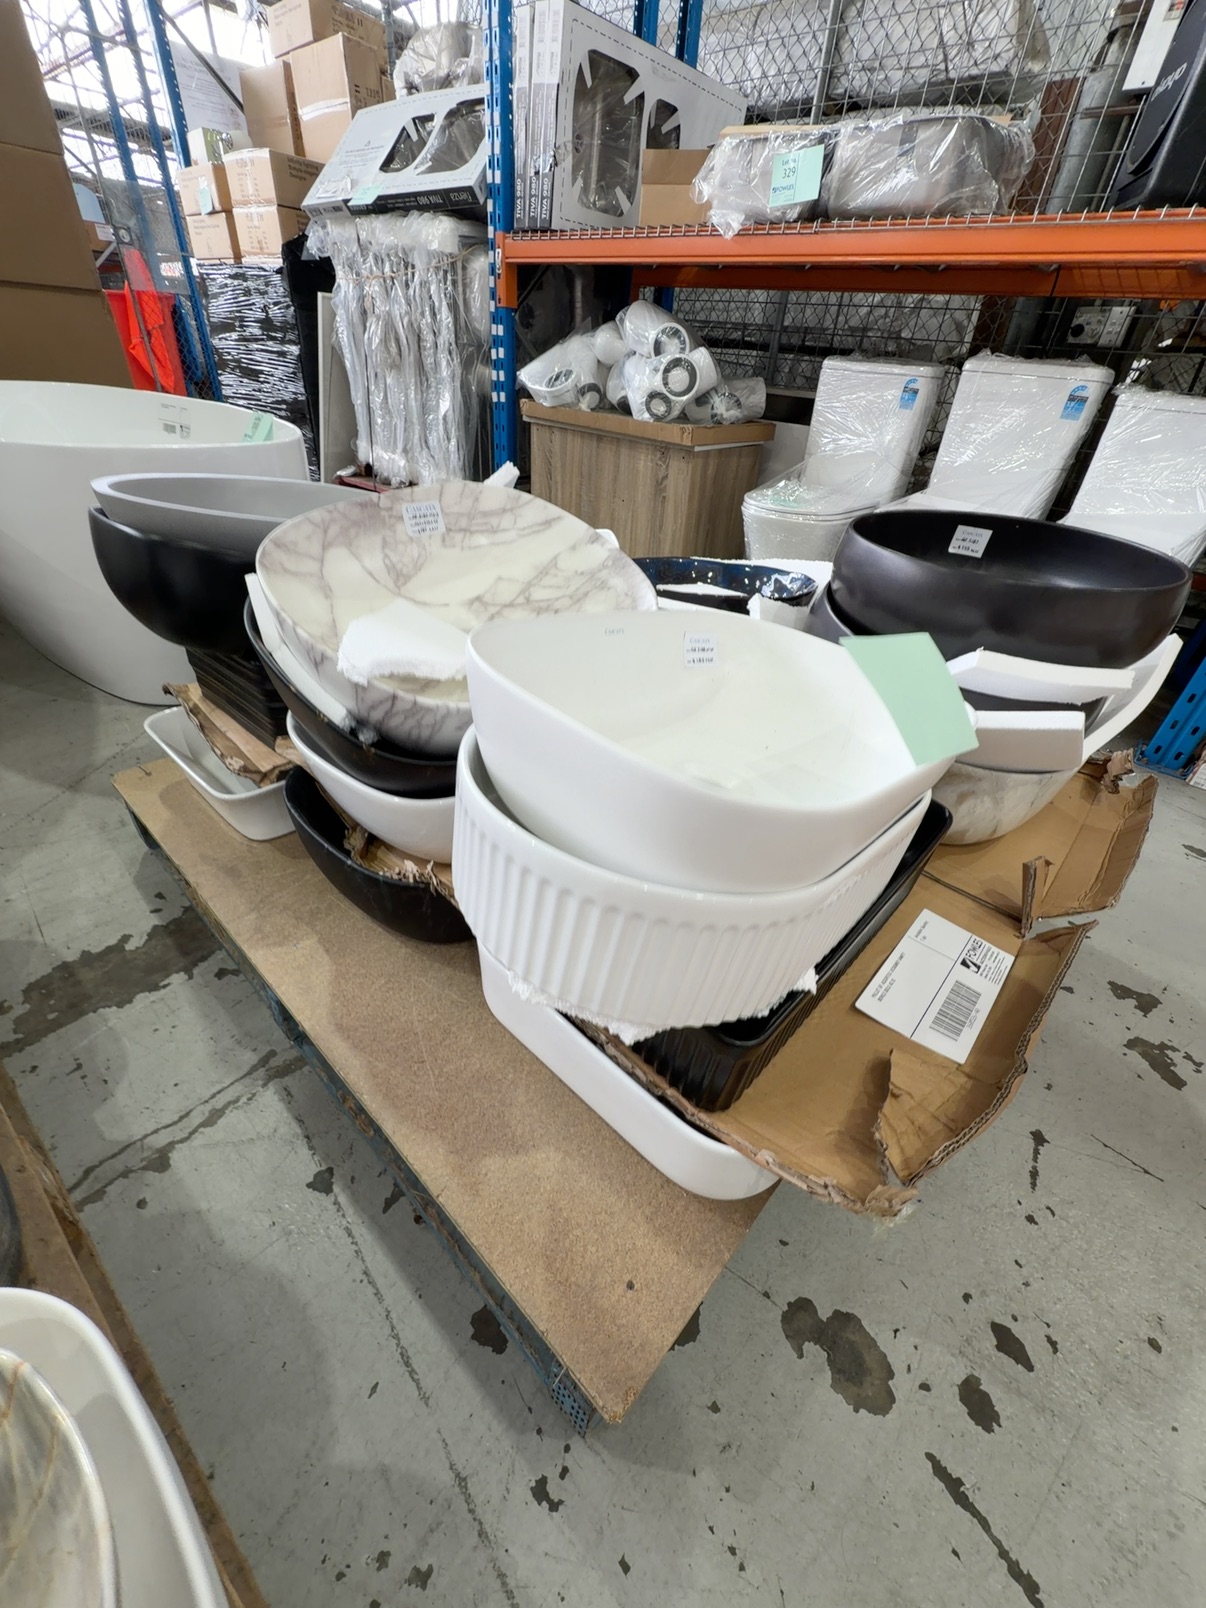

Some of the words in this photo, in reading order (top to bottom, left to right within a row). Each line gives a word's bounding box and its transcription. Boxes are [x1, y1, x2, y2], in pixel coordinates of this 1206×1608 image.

[782, 166, 797, 179] 329
[428, 194, 444, 204] TIVA
[965, 938, 983, 960] FOWLES
